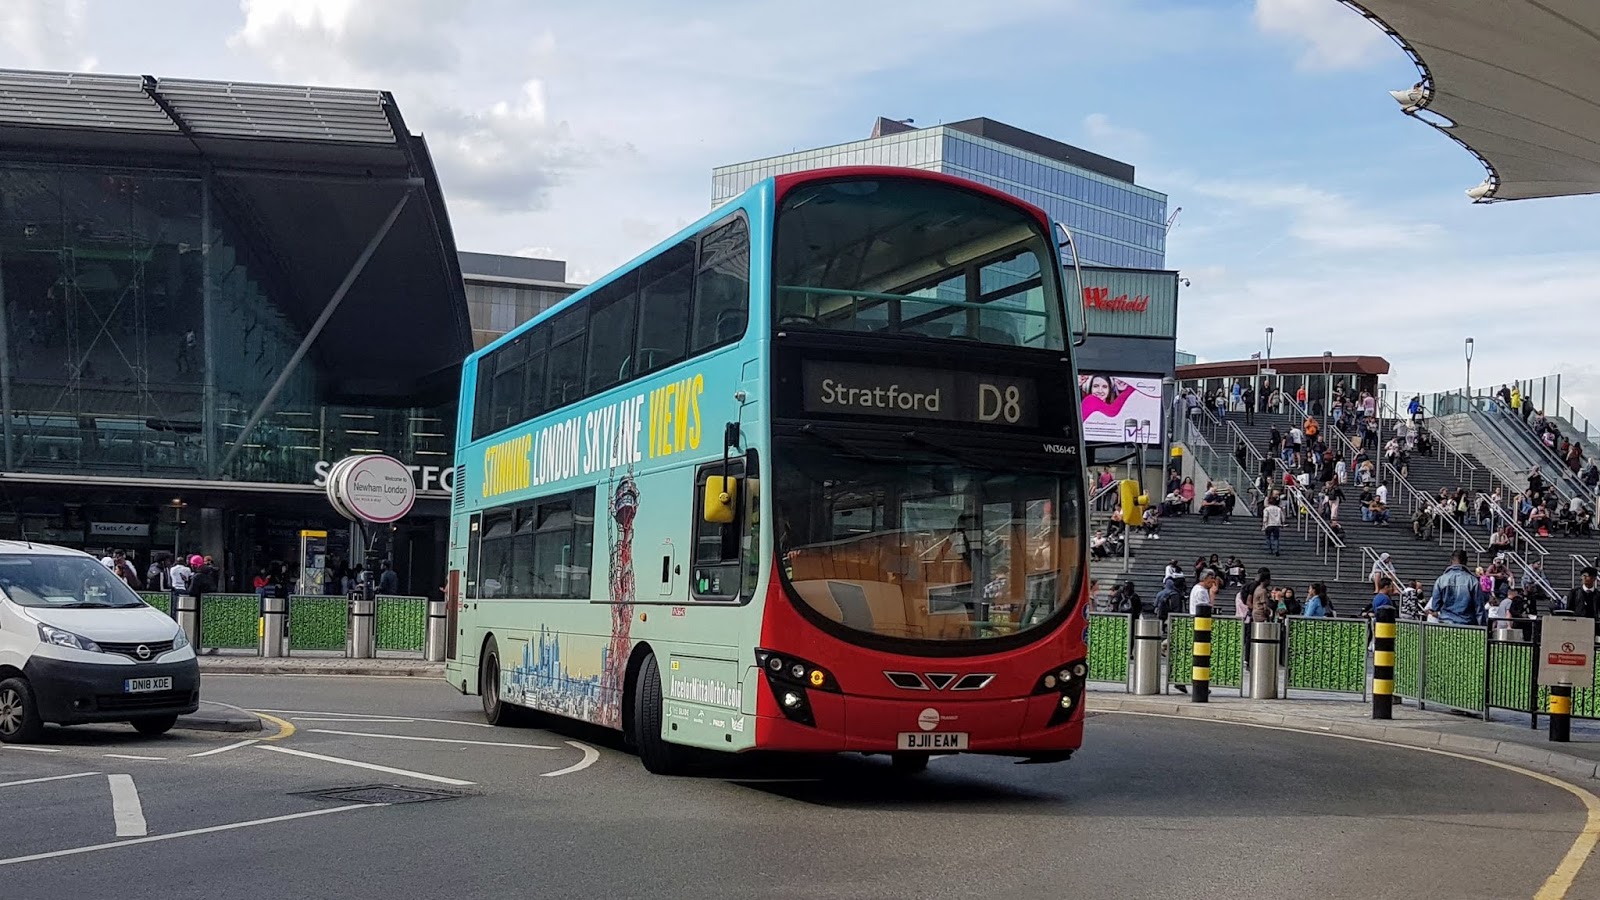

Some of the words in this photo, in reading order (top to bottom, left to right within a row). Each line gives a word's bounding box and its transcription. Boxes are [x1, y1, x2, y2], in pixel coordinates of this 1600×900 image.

[1083, 286, 1150, 312] Westfield
[820, 378, 940, 412] Stratford
[978, 383, 1021, 424] D8
[482, 433, 532, 498] STUNNING
[533, 415, 582, 487] LONDON
[583, 393, 645, 474] SKYLINE
[649, 373, 704, 459] VIEWS
[1043, 443, 1076, 455] VN36142
[353, 482, 383, 493] Newham
[383, 484, 408, 494] London
[132, 679, 151, 690] DN18
[153, 678, 169, 689] XDE
[670, 674, 742, 708] ArcelorMittalOrbit.com
[908, 734, 931, 748] BJ11
[934, 734, 958, 748] EAM
